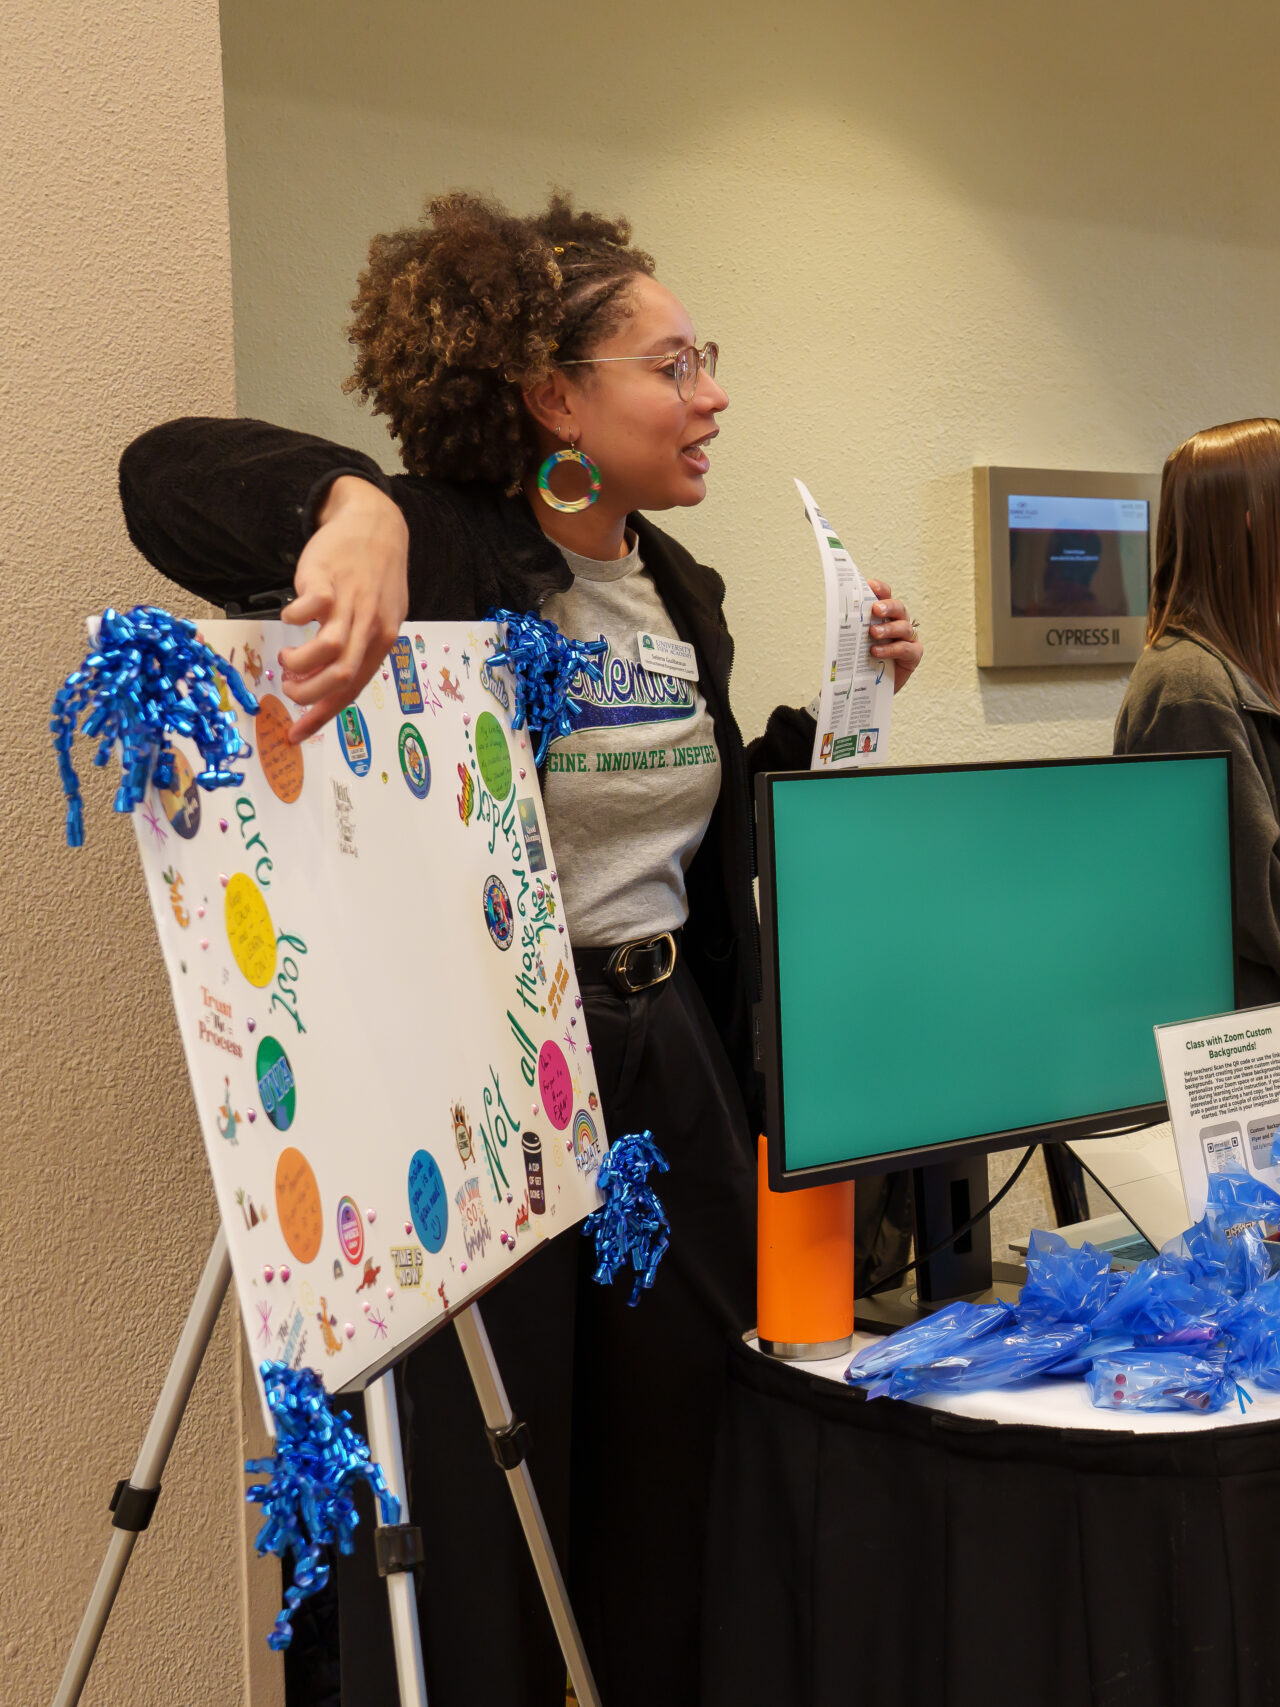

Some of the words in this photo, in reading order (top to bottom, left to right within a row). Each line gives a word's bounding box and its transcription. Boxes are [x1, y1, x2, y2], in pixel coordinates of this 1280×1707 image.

[1046, 629, 1109, 646] CYPRESS
[1113, 629, 1120, 645] II
[481, 661, 509, 712] Smile
[401, 692, 421, 705] PROUD
[596, 750, 668, 771] INNOVATE.
[673, 745, 717, 766] INSPIRE
[235, 797, 273, 886] are
[515, 923, 539, 1014] those
[201, 986, 232, 1018] Trust
[199, 1020, 243, 1058] Process
[507, 1009, 537, 1087] all
[1186, 1039, 1205, 1050] Class
[1207, 1036, 1223, 1047] with
[1224, 1033, 1244, 1042] Zoom
[1246, 1027, 1272, 1038] Custom
[1209, 1042, 1257, 1059] Backgrounds!
[1215, 1068, 1233, 1077] creating
[1253, 1065, 1280, 1076] backgrounds
[257, 1055, 294, 1113] UVA
[1188, 1086, 1212, 1096] personalize
[1190, 1099, 1212, 1108] interested
[1222, 1093, 1238, 1102] starting
[1197, 1092, 1212, 1101] during
[1213, 1088, 1230, 1097] learning
[1190, 1108, 1200, 1116] grab
[1204, 1104, 1218, 1112] poster
[1231, 1098, 1246, 1106] couple
[480, 1064, 520, 1203] Not
[1250, 1125, 1265, 1133] Custom
[1251, 1134, 1262, 1143] Flyer
[576, 1139, 601, 1171] RADIATE
[467, 1203, 477, 1226] SO
[464, 1215, 491, 1260] bright
[391, 1249, 412, 1267] TIME
[415, 1249, 422, 1266] IS
[400, 1268, 420, 1286] NOW
